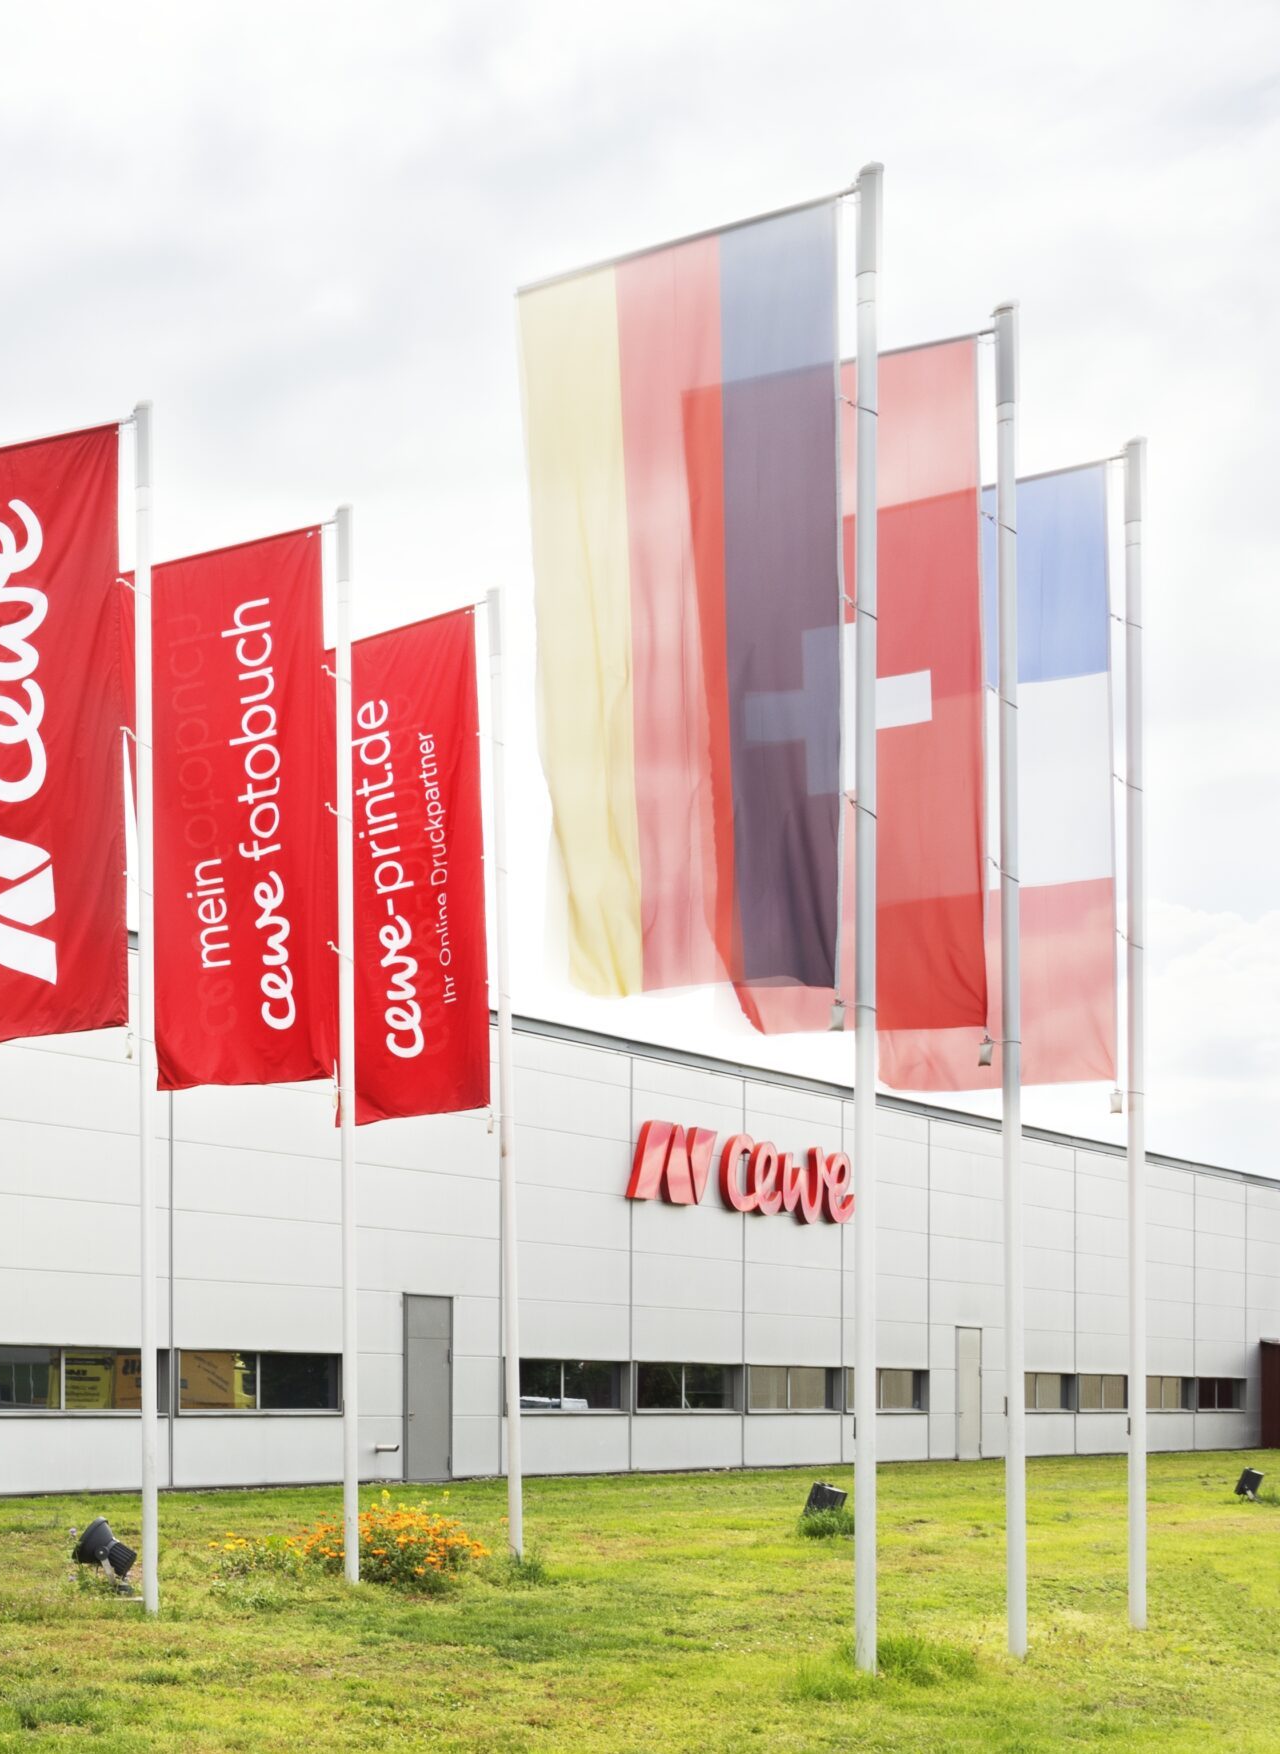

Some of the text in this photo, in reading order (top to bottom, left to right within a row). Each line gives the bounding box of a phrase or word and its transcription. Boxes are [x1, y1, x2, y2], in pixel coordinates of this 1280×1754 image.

[185, 857, 233, 969] mein
[219, 596, 297, 1031] cewe fotobuch
[351, 697, 426, 1060] cewe-print.de
[417, 731, 458, 1005] Ihr Online Druckpartner
[719, 1132, 856, 1226] cewe
